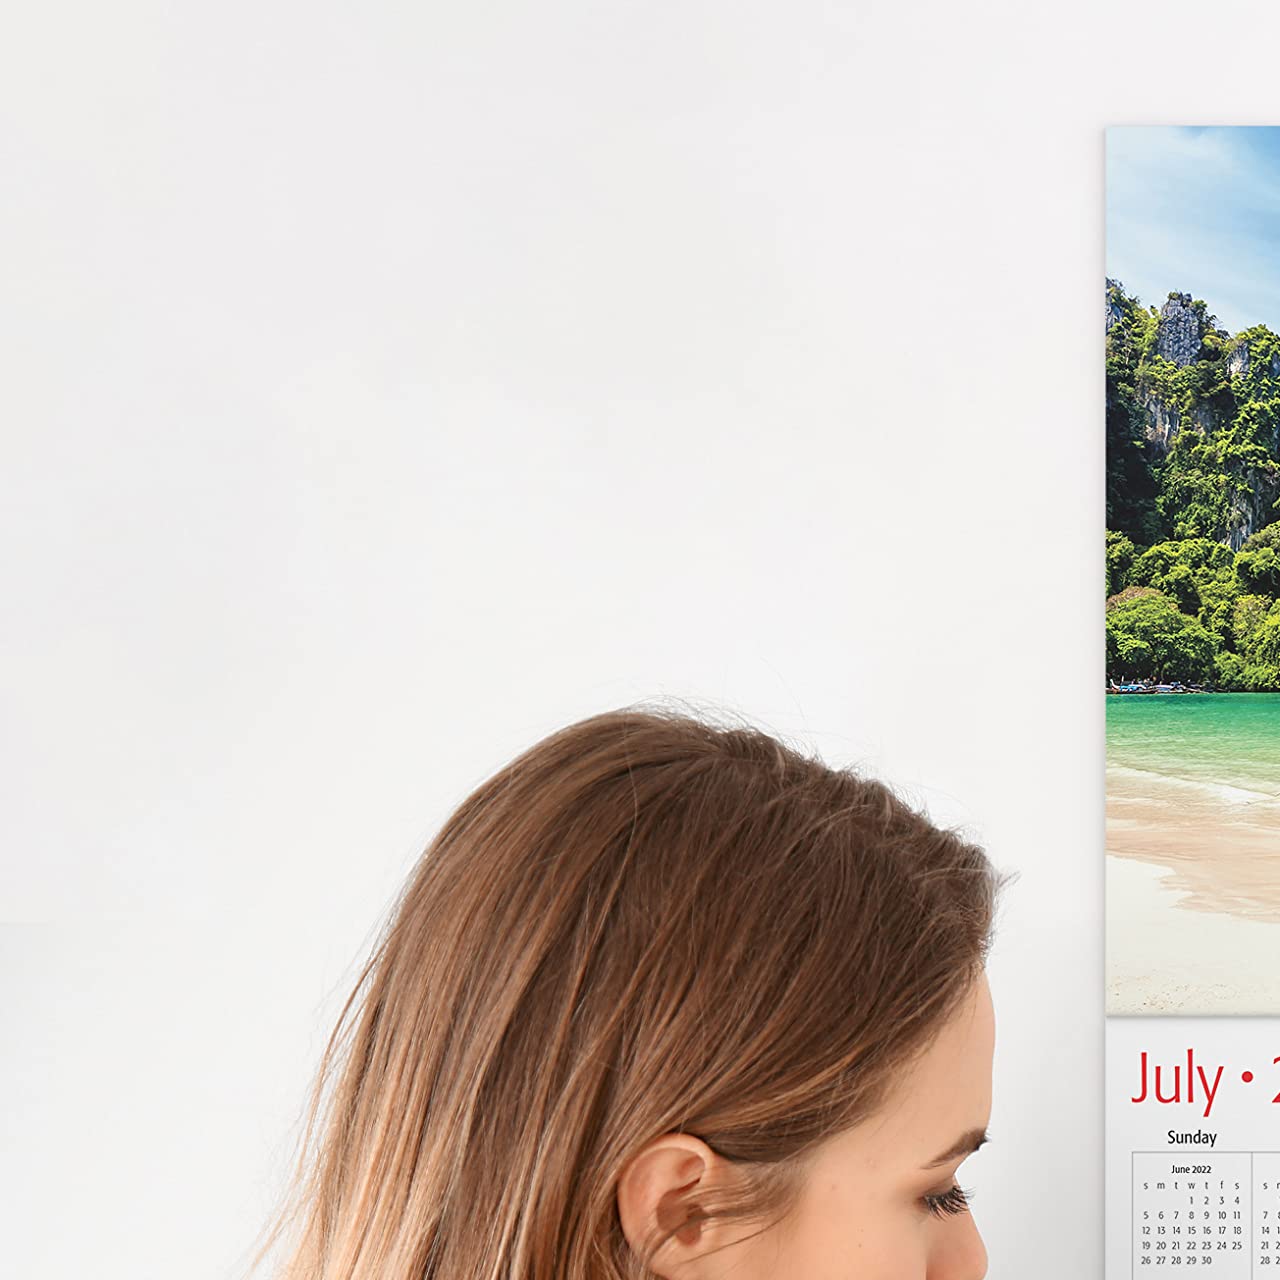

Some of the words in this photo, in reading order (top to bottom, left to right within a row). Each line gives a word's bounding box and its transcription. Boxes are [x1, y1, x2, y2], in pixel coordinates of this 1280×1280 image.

[1132, 1049, 1224, 1117] July
[1167, 1129, 1218, 1148] Sunday
[1171, 1164, 1191, 1174] June
[1191, 1165, 1212, 1174] 2022
[1189, 1196, 1194, 1205] 1
[1203, 1195, 1210, 1206] 2
[1219, 1196, 1225, 1205] 3
[1234, 1196, 1240, 1205] 4
[1143, 1210, 1150, 1220] 5
[1158, 1210, 1165, 1220] 6
[1174, 1210, 1179, 1220] 7
[1188, 1210, 1195, 1220] 8
[1203, 1210, 1210, 1220] 9
[1218, 1210, 1227, 1220] 10
[1233, 1210, 1241, 1220] 11
[1263, 1210, 1269, 1220] 7
[1141, 1225, 1151, 1235] 12
[1157, 1226, 1166, 1235] 13
[1172, 1226, 1181, 1235] 14
[1187, 1225, 1197, 1235] 15
[1202, 1226, 1212, 1235] 16
[1218, 1225, 1227, 1235] 17
[1233, 1226, 1242, 1235] 18
[1261, 1226, 1270, 1235] 14
[1141, 1240, 1151, 1251] 19
[1155, 1240, 1167, 1251] 20
[1171, 1241, 1180, 1251] 21
[1186, 1241, 1197, 1251] 22
[1201, 1241, 1213, 1251] 23
[1216, 1241, 1227, 1250] 24
[1231, 1241, 1243, 1251] 25
[1260, 1240, 1269, 1250] 21
[1140, 1255, 1152, 1265] 26
[1156, 1255, 1166, 1265] 27
[1171, 1255, 1182, 1265] 28
[1186, 1255, 1197, 1265] 29
[1201, 1255, 1213, 1265] 30
[1259, 1255, 1271, 1265] 28
